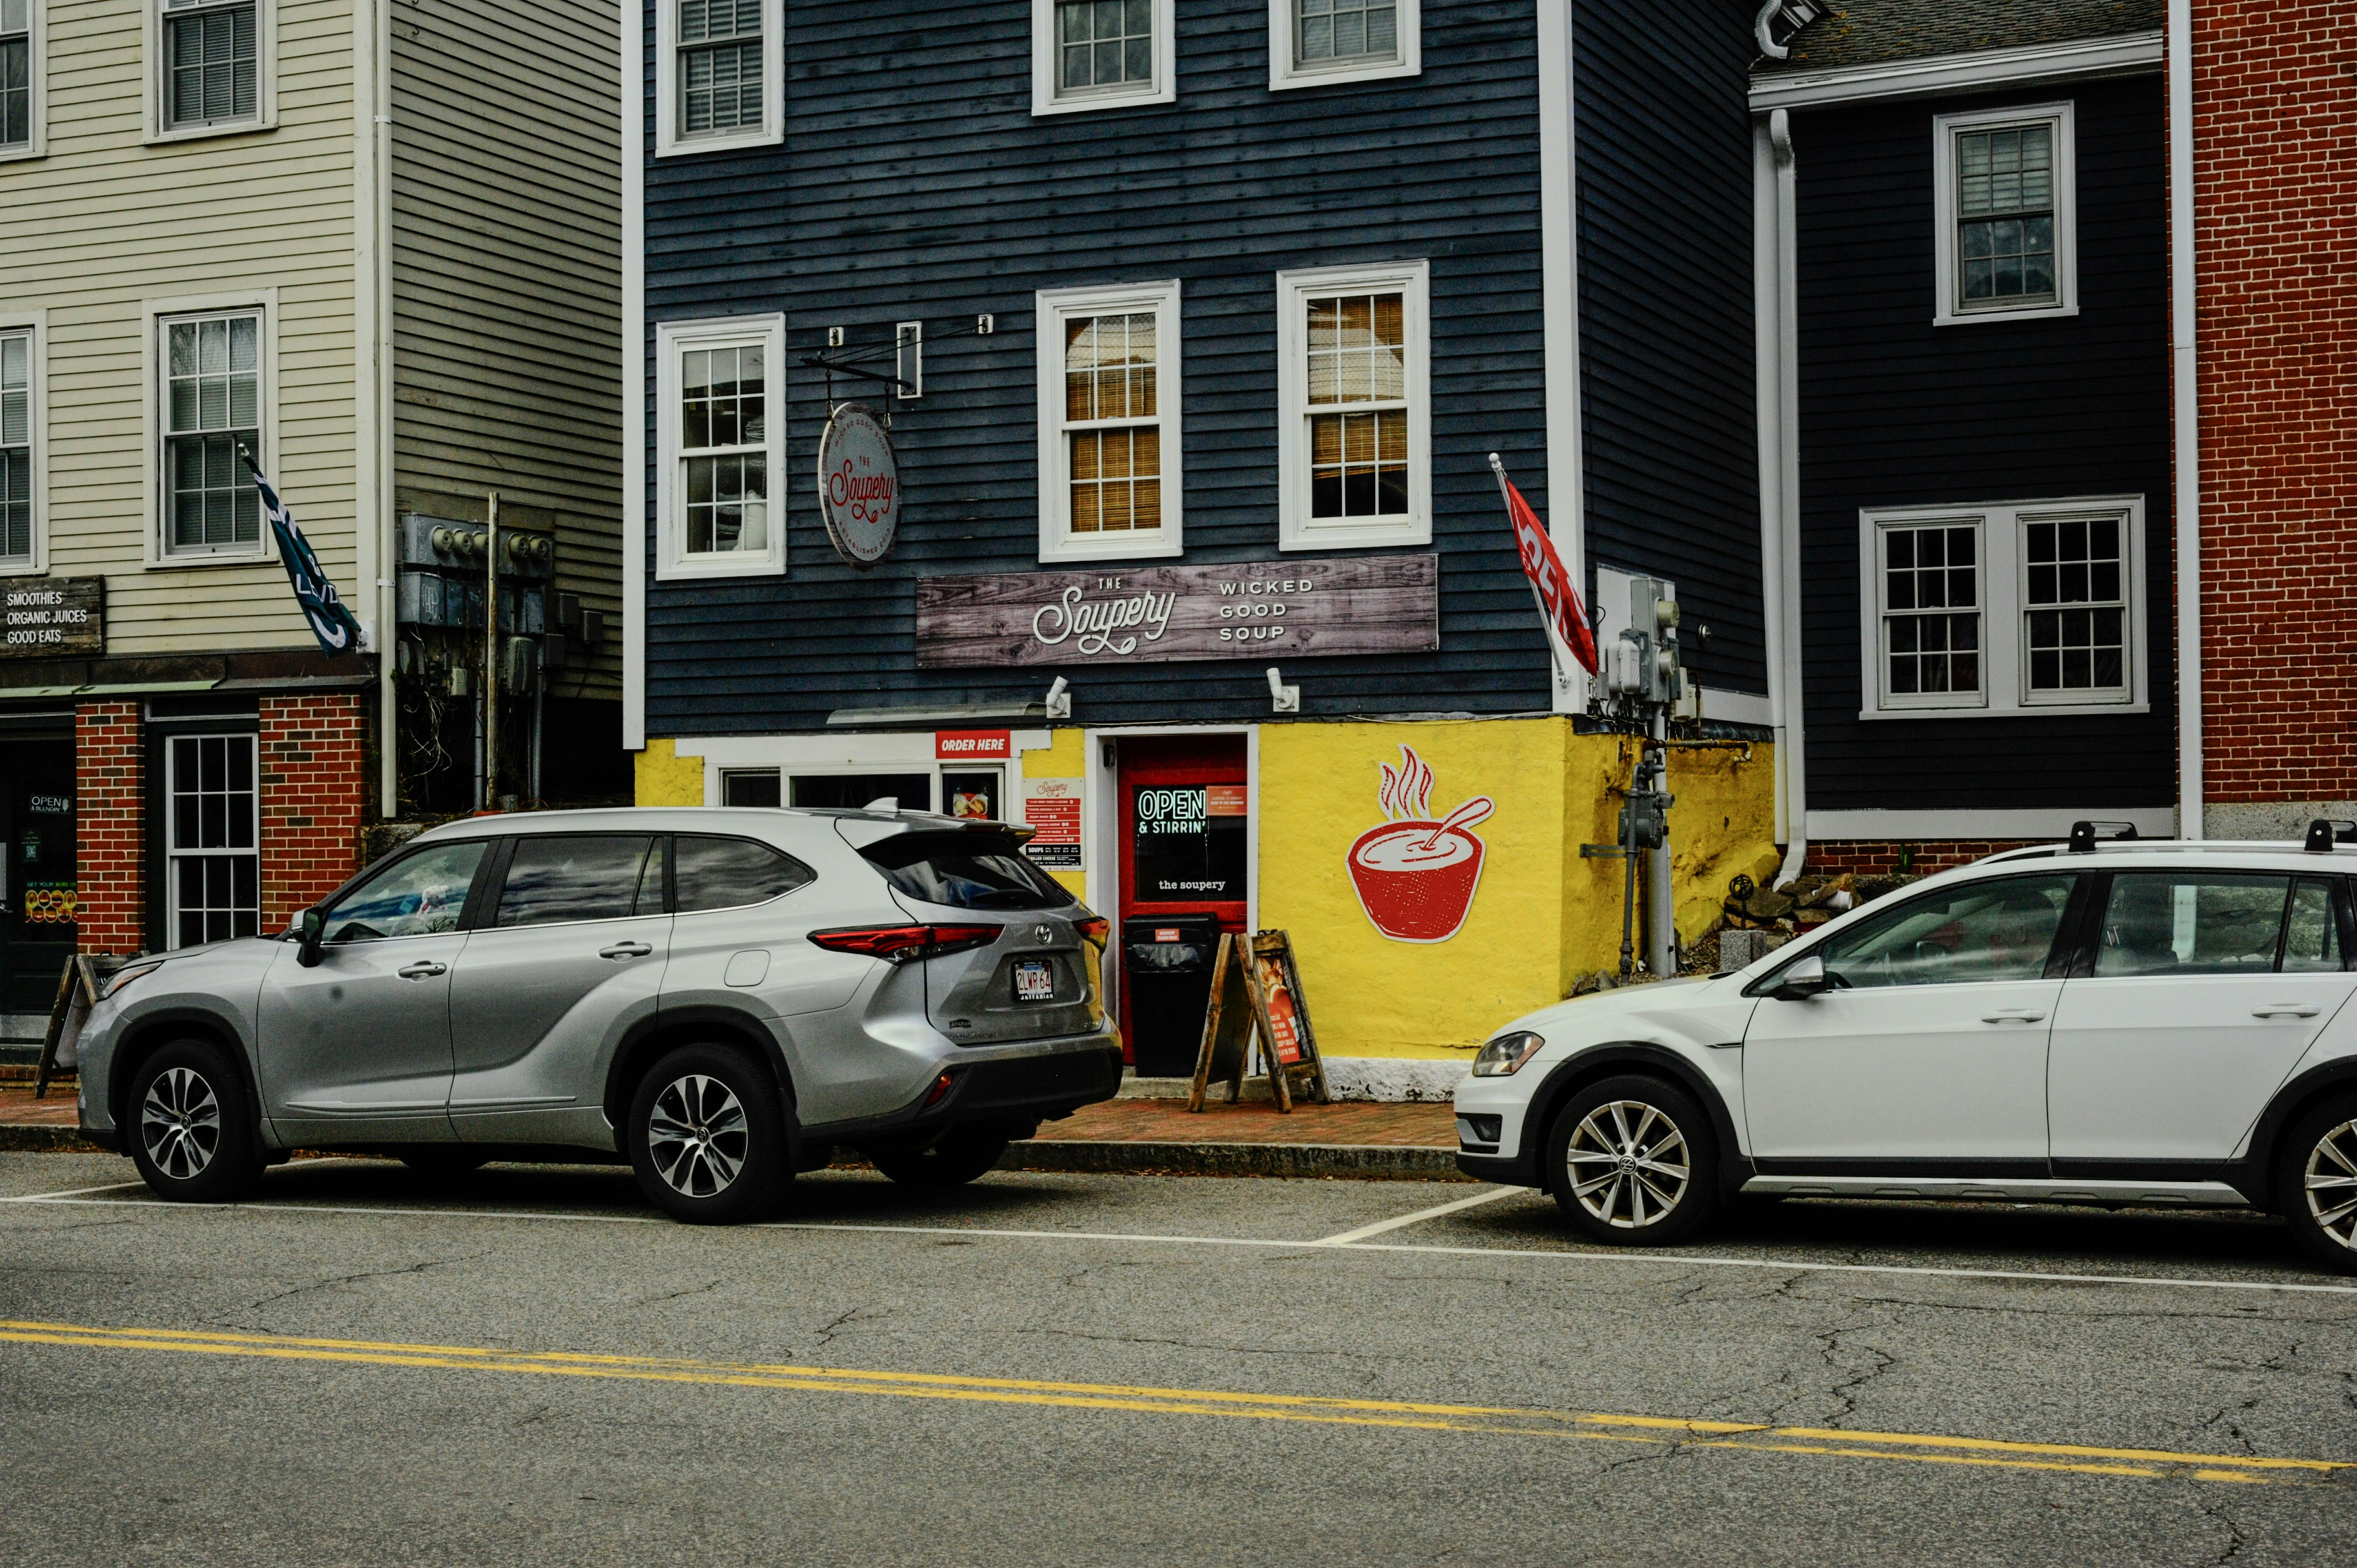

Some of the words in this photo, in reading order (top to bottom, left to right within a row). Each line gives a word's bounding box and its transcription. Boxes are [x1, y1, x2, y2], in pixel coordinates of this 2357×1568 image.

[856, 419, 873, 430] GOOD
[859, 456, 869, 467] THE
[830, 459, 894, 524] Soupery
[1098, 577, 1121, 590] THE
[1219, 580, 1313, 596] WICKED
[7, 592, 63, 606] SMOOTHIES
[7, 611, 50, 625] ORGANIC
[53, 610, 87, 623] JUICES
[1219, 604, 1286, 618] GOOD
[1033, 586, 1176, 655] Soupery
[7, 631, 37, 644] GOOD
[39, 630, 61, 643] EATS
[1219, 626, 1285, 641] SOUP
[941, 739, 976, 751] ORDER
[977, 738, 1005, 750] HERE
[1037, 781, 1068, 797] Soupery
[32, 796, 61, 807] OPEN
[1139, 790, 1206, 820] OPEN
[1139, 821, 1148, 834] &
[1152, 821, 1206, 834] STIRRIN'
[1159, 880, 1177, 889] the
[1180, 881, 1226, 891] soupery
[1017, 972, 1038, 990] 2LWR
